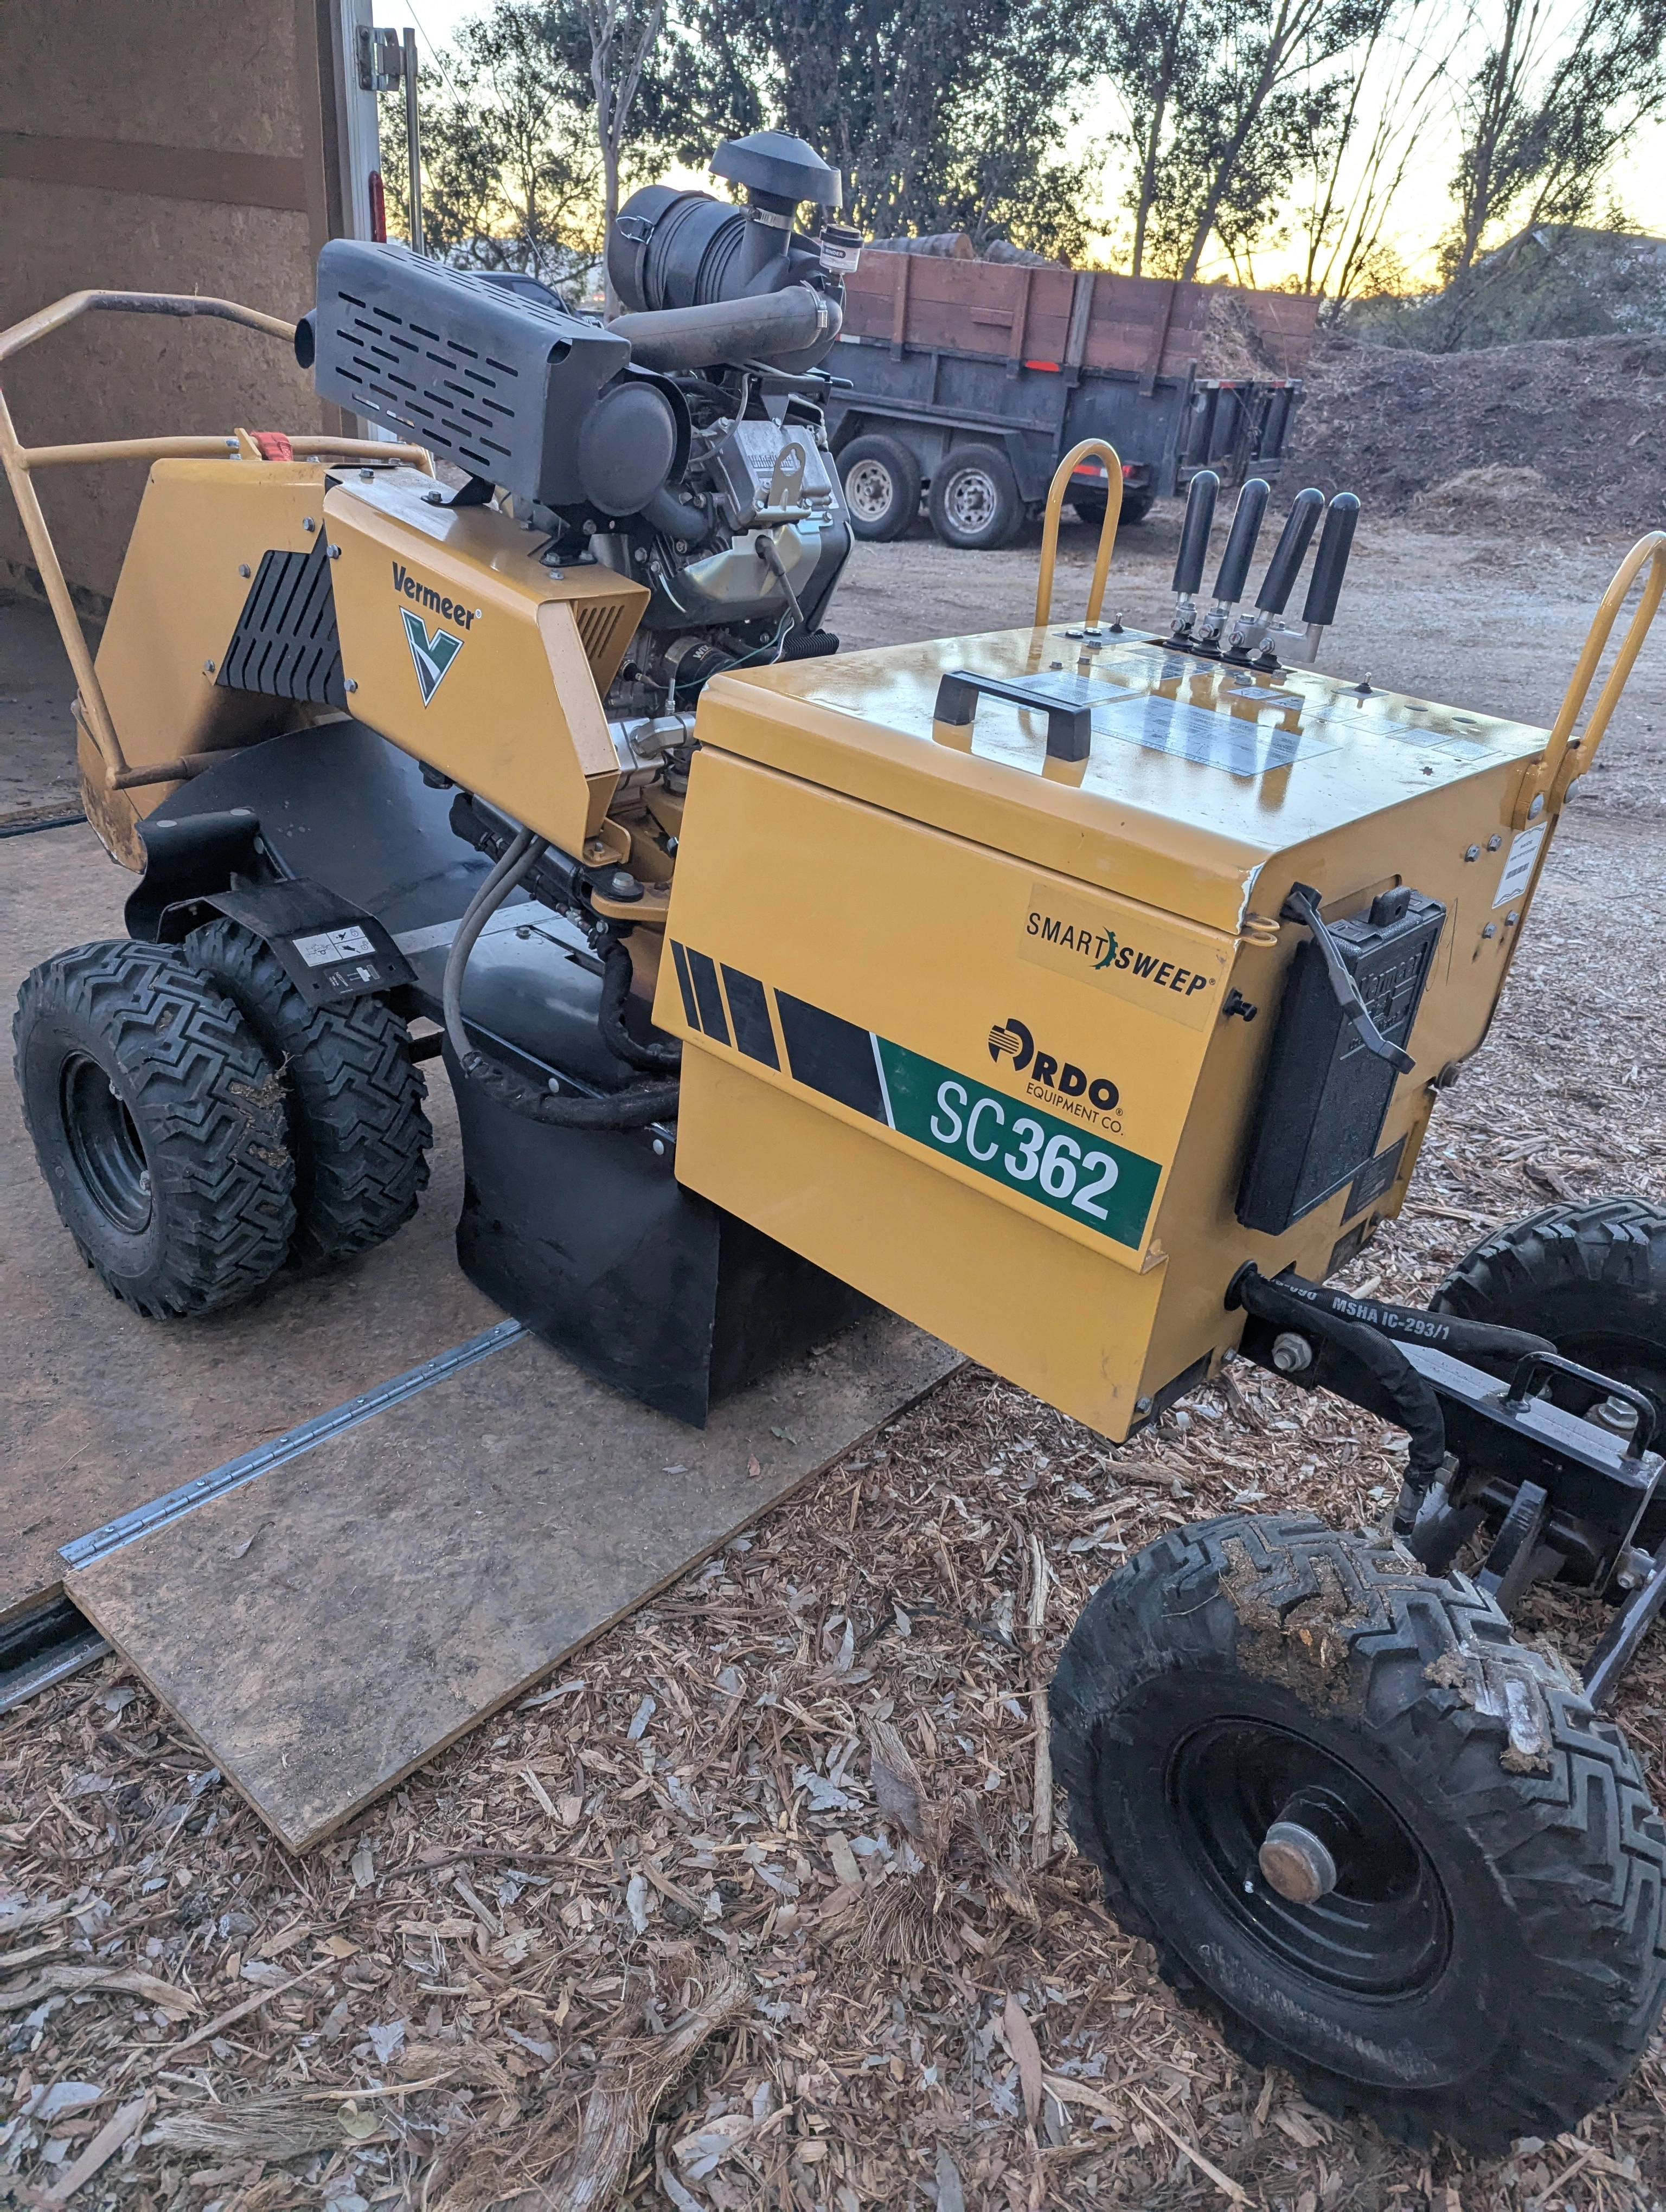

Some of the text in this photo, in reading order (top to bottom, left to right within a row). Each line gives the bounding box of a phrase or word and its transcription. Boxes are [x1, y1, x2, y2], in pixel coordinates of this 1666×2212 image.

[693, 645, 712, 658] WIX
[1026, 912, 1108, 960] SMART
[1026, 1082, 1124, 1136] EQUIPMENT CO.
[1332, 1296, 1450, 1340] MSHA IC-293/1
